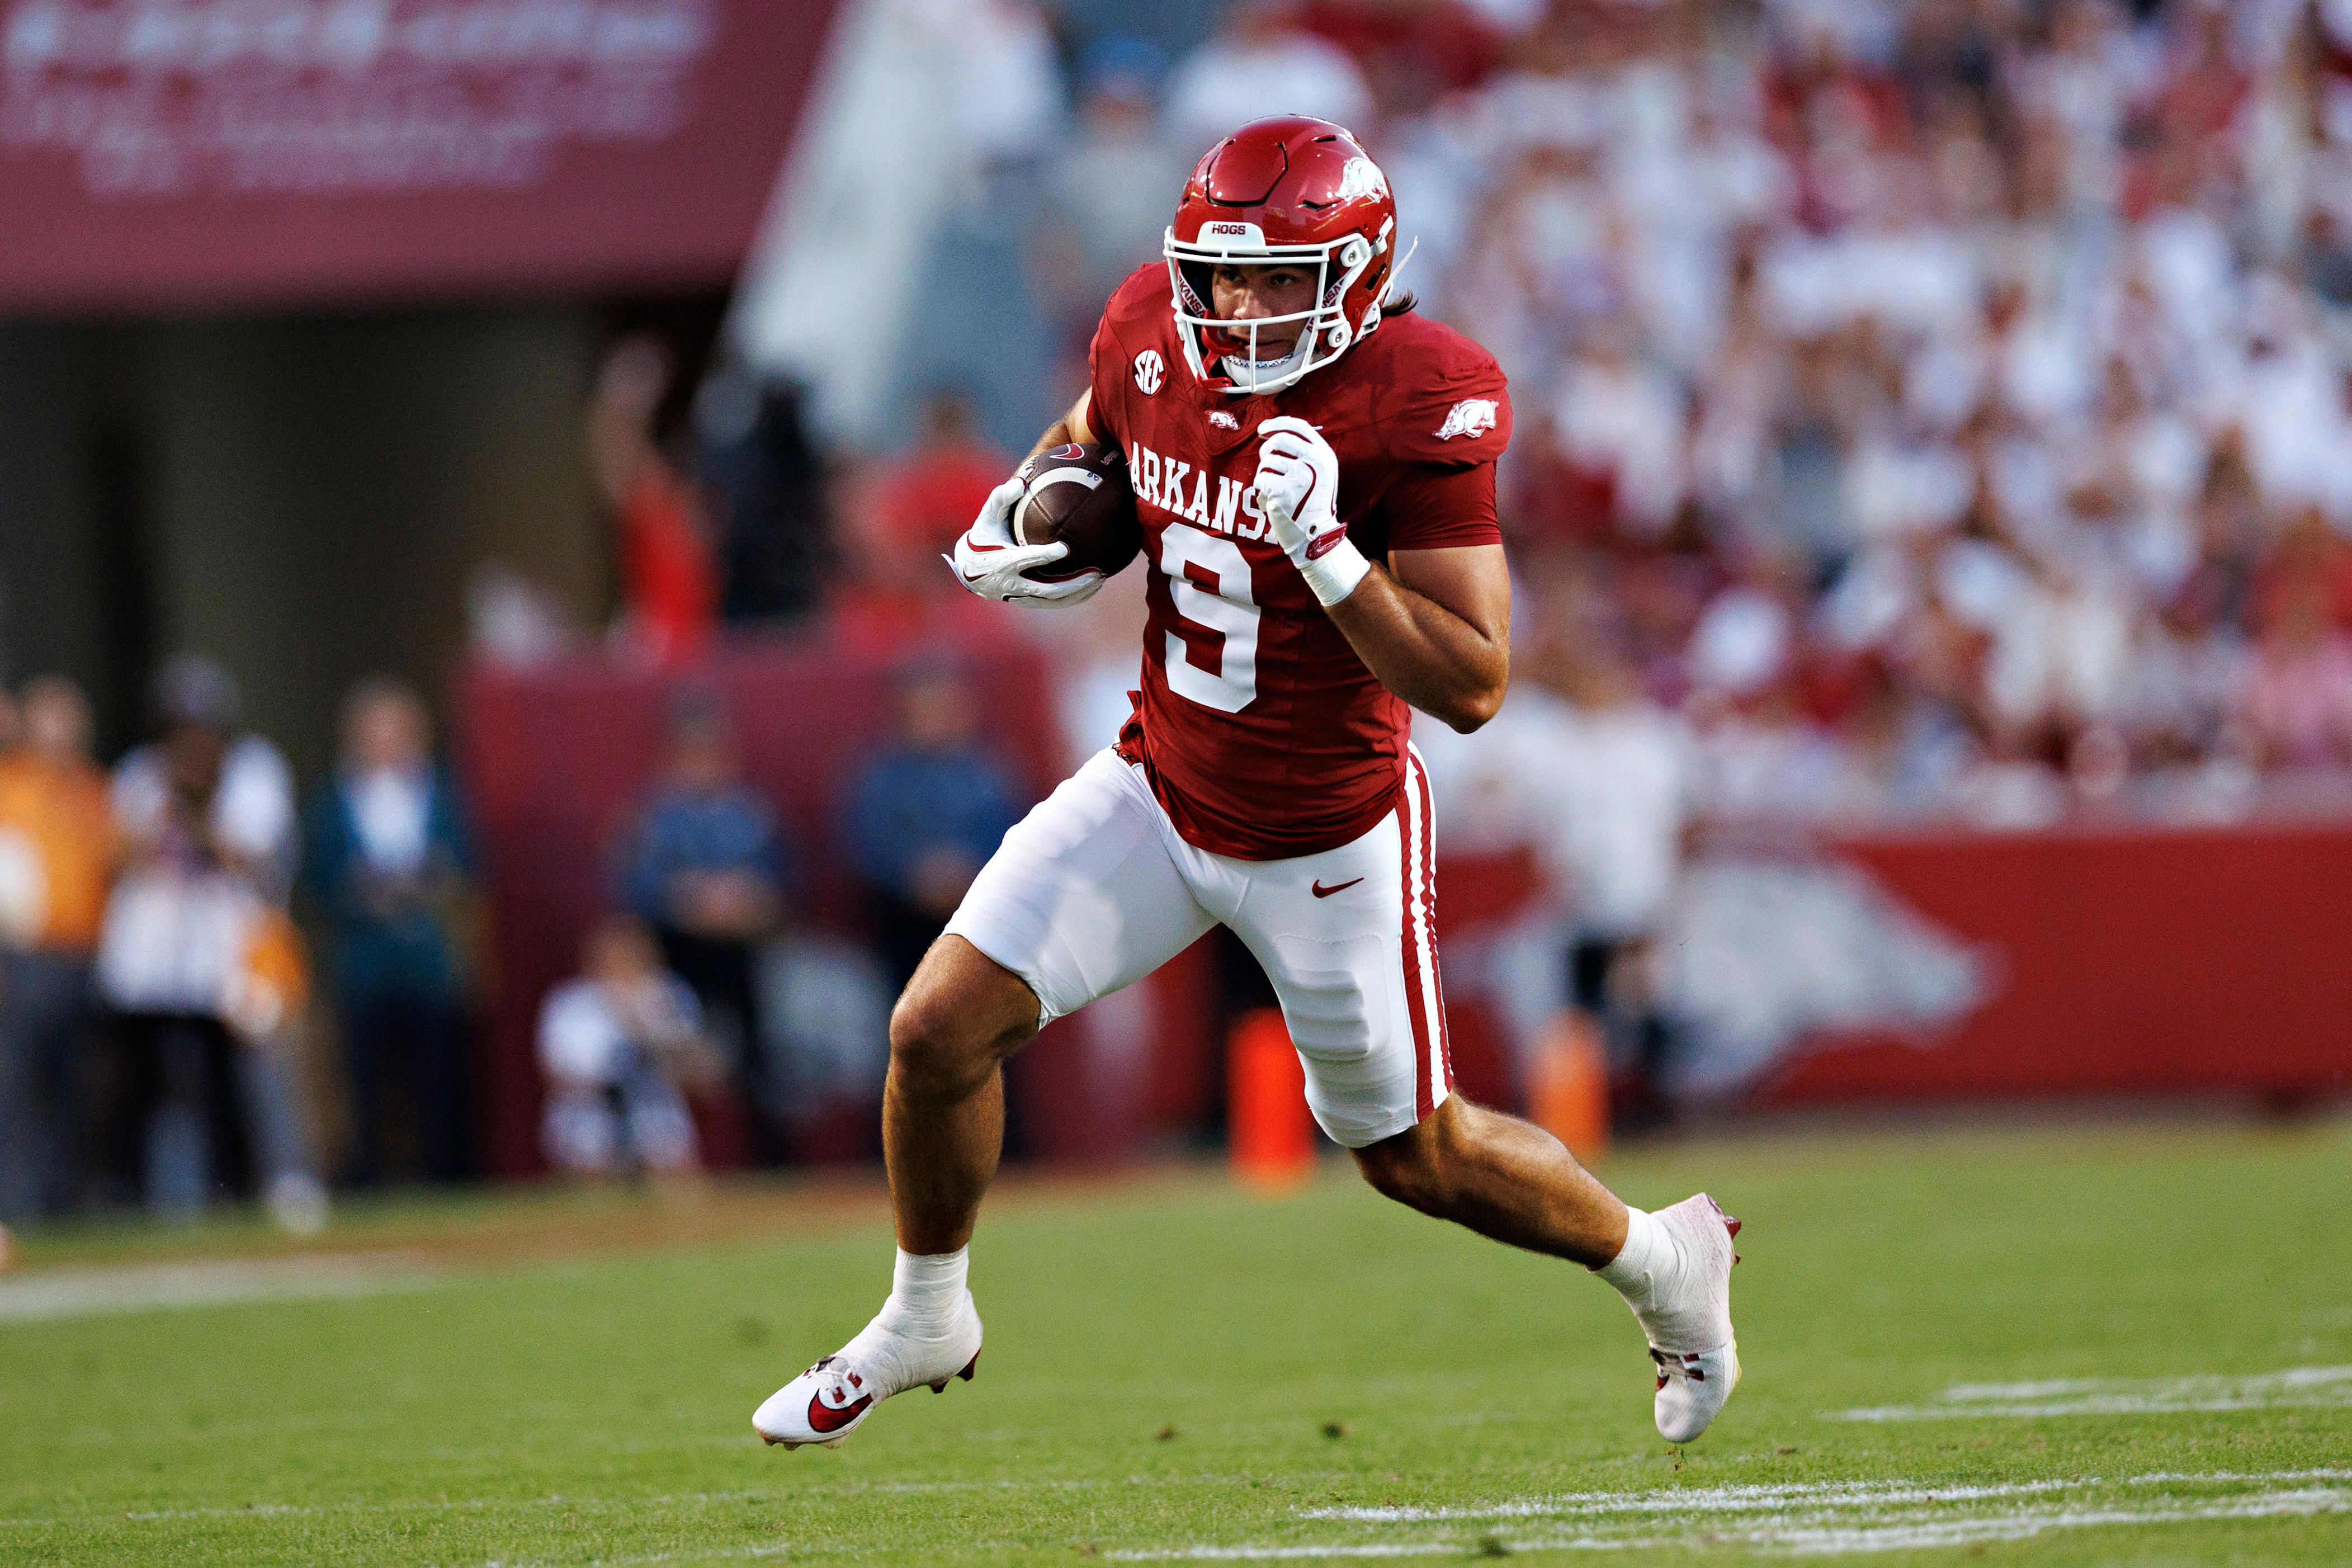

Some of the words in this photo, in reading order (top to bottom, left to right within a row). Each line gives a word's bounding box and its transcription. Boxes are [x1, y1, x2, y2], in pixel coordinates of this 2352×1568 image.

[1212, 224, 1246, 235] HOGS
[1134, 350, 1164, 395] SEC
[1130, 441, 1278, 545] ARKANS
[1160, 522, 1261, 714] 9
